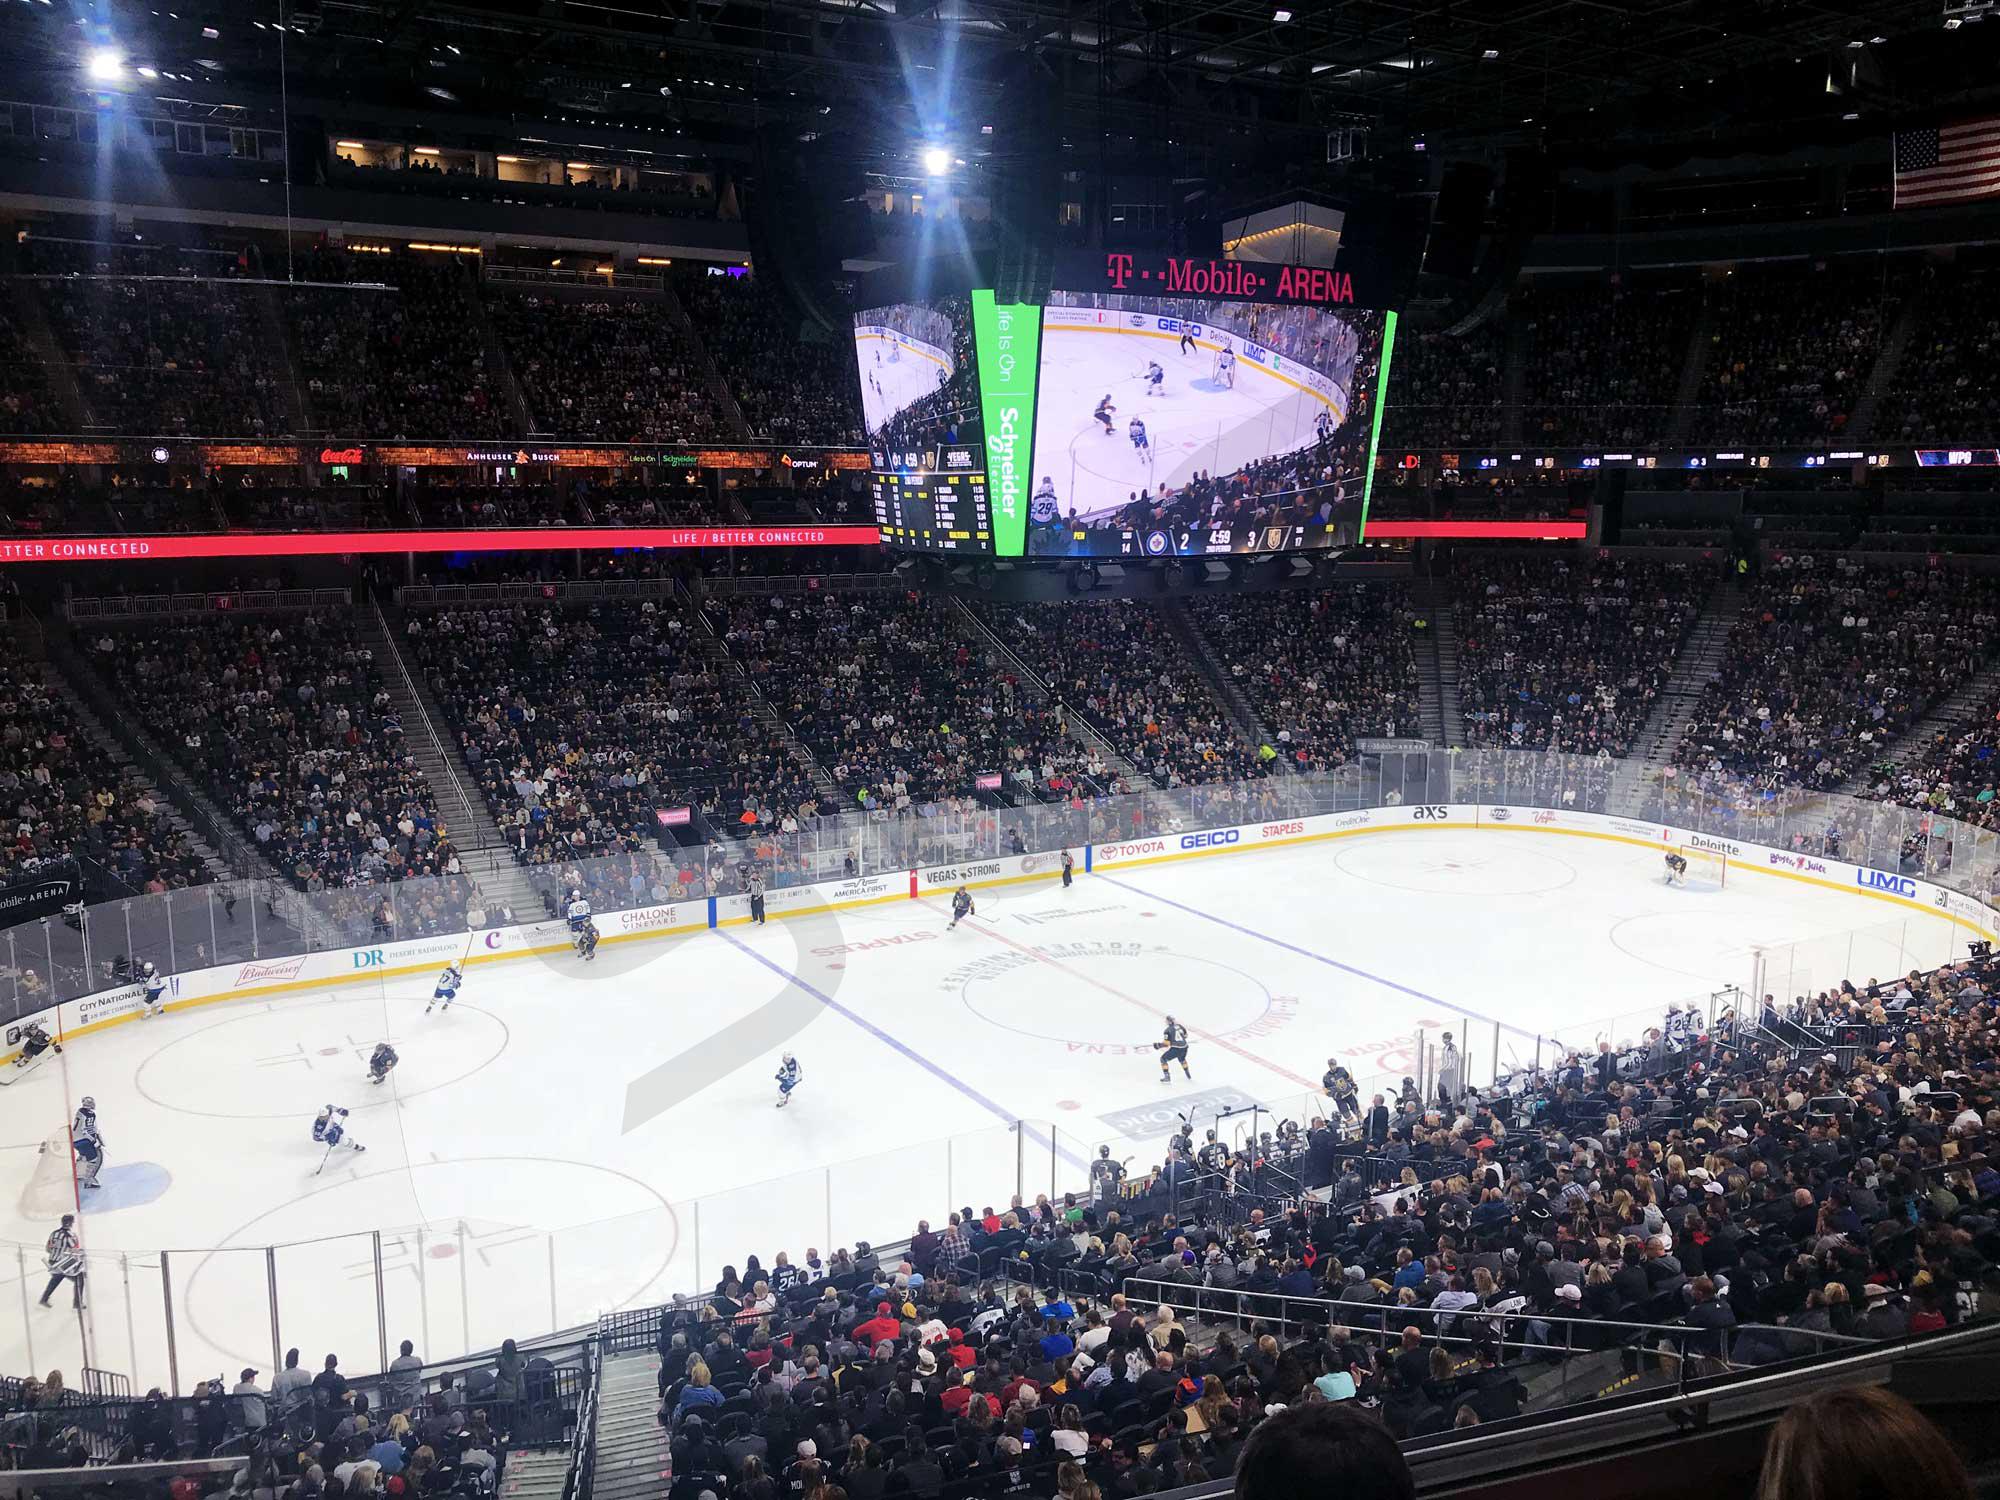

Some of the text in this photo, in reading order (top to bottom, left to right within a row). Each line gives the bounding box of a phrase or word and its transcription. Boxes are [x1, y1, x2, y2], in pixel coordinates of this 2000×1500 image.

[1276, 266, 1354, 304] ARENA
[1158, 318, 1202, 338] GEIO
[999, 336, 1013, 350] Is
[999, 353, 1016, 382] On
[662, 455, 699, 463] Schneider
[1000, 407, 1020, 518] Schneider
[1701, 458, 1706, 466] 3
[1750, 457, 1756, 466] 2
[991, 455, 1001, 514] Electric
[1038, 502, 1053, 516] 29
[672, 533, 697, 544] LIFE
[712, 532, 755, 544] BETTER
[759, 531, 825, 543] CONNECTED
[1179, 533, 1189, 551] 2
[1209, 530, 1231, 545] 4:59
[1247, 531, 1256, 548] 3
[1294, 537, 1303, 547] 17
[0, 542, 150, 558] TTER CONNECTED
[1121, 543, 1131, 554] 14
[1262, 823, 1304, 838] STAPLES
[1180, 829, 1240, 850] GEICO
[1119, 841, 1165, 857] TOYOTA
[926, 863, 1001, 884] VEGAS STRONG
[1804, 859, 1827, 874] Juice
[834, 884, 888, 898] AMERICA FIRST
[1856, 868, 1917, 898] UMC
[29, 888, 65, 902] ARENA
[621, 907, 677, 925] CHALONE
[622, 916, 678, 931] VINEYARD
[417, 944, 459, 958] RADIOLOGY
[810, 930, 939, 957] STAPLES
[352, 949, 385, 968] DR
[243, 964, 300, 980] Budweiser
[79, 991, 144, 1013] CITY NATIONAL
[1067, 1041, 1153, 1057] RENA
